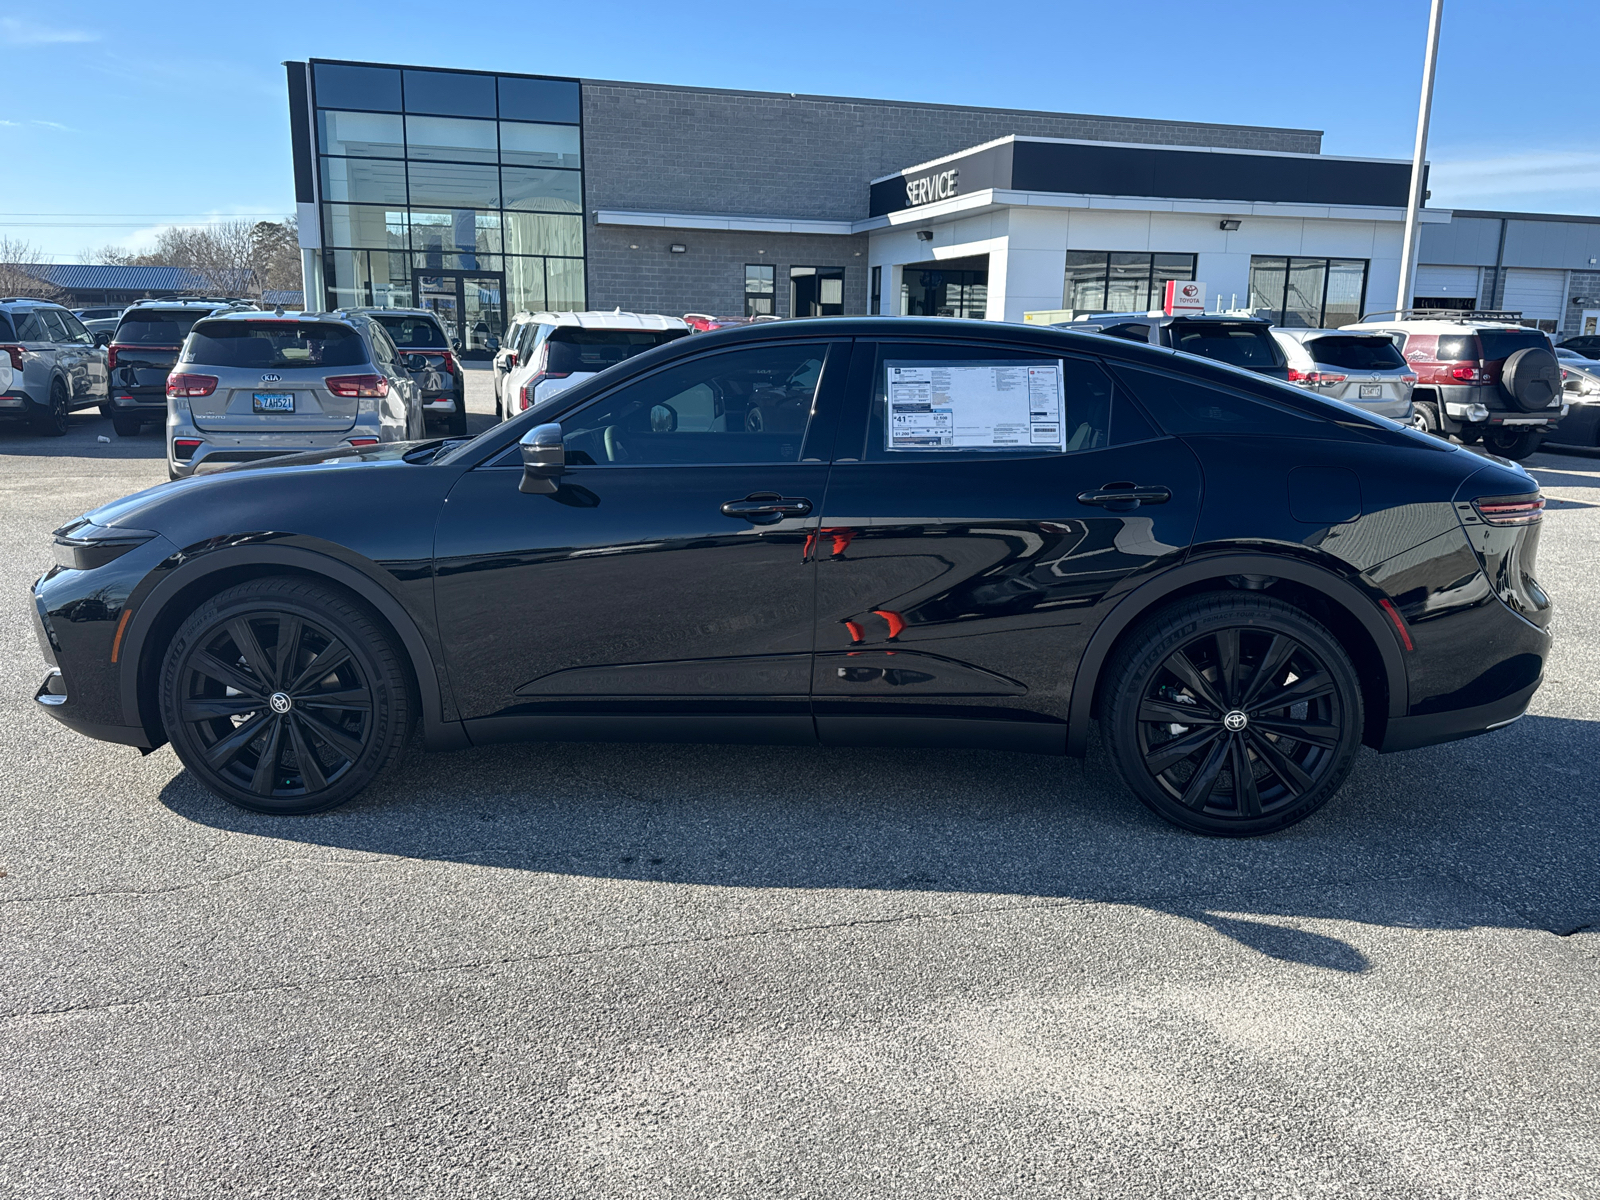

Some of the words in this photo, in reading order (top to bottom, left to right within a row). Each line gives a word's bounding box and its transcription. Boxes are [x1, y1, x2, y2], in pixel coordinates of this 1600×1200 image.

[906, 169, 956, 205] SERVICE
[1202, 612, 1233, 624] PRIMACY
[164, 641, 184, 708] MICHELIN
[1137, 623, 1194, 678] MICHELIN
[366, 703, 388, 769] MICHELIN
